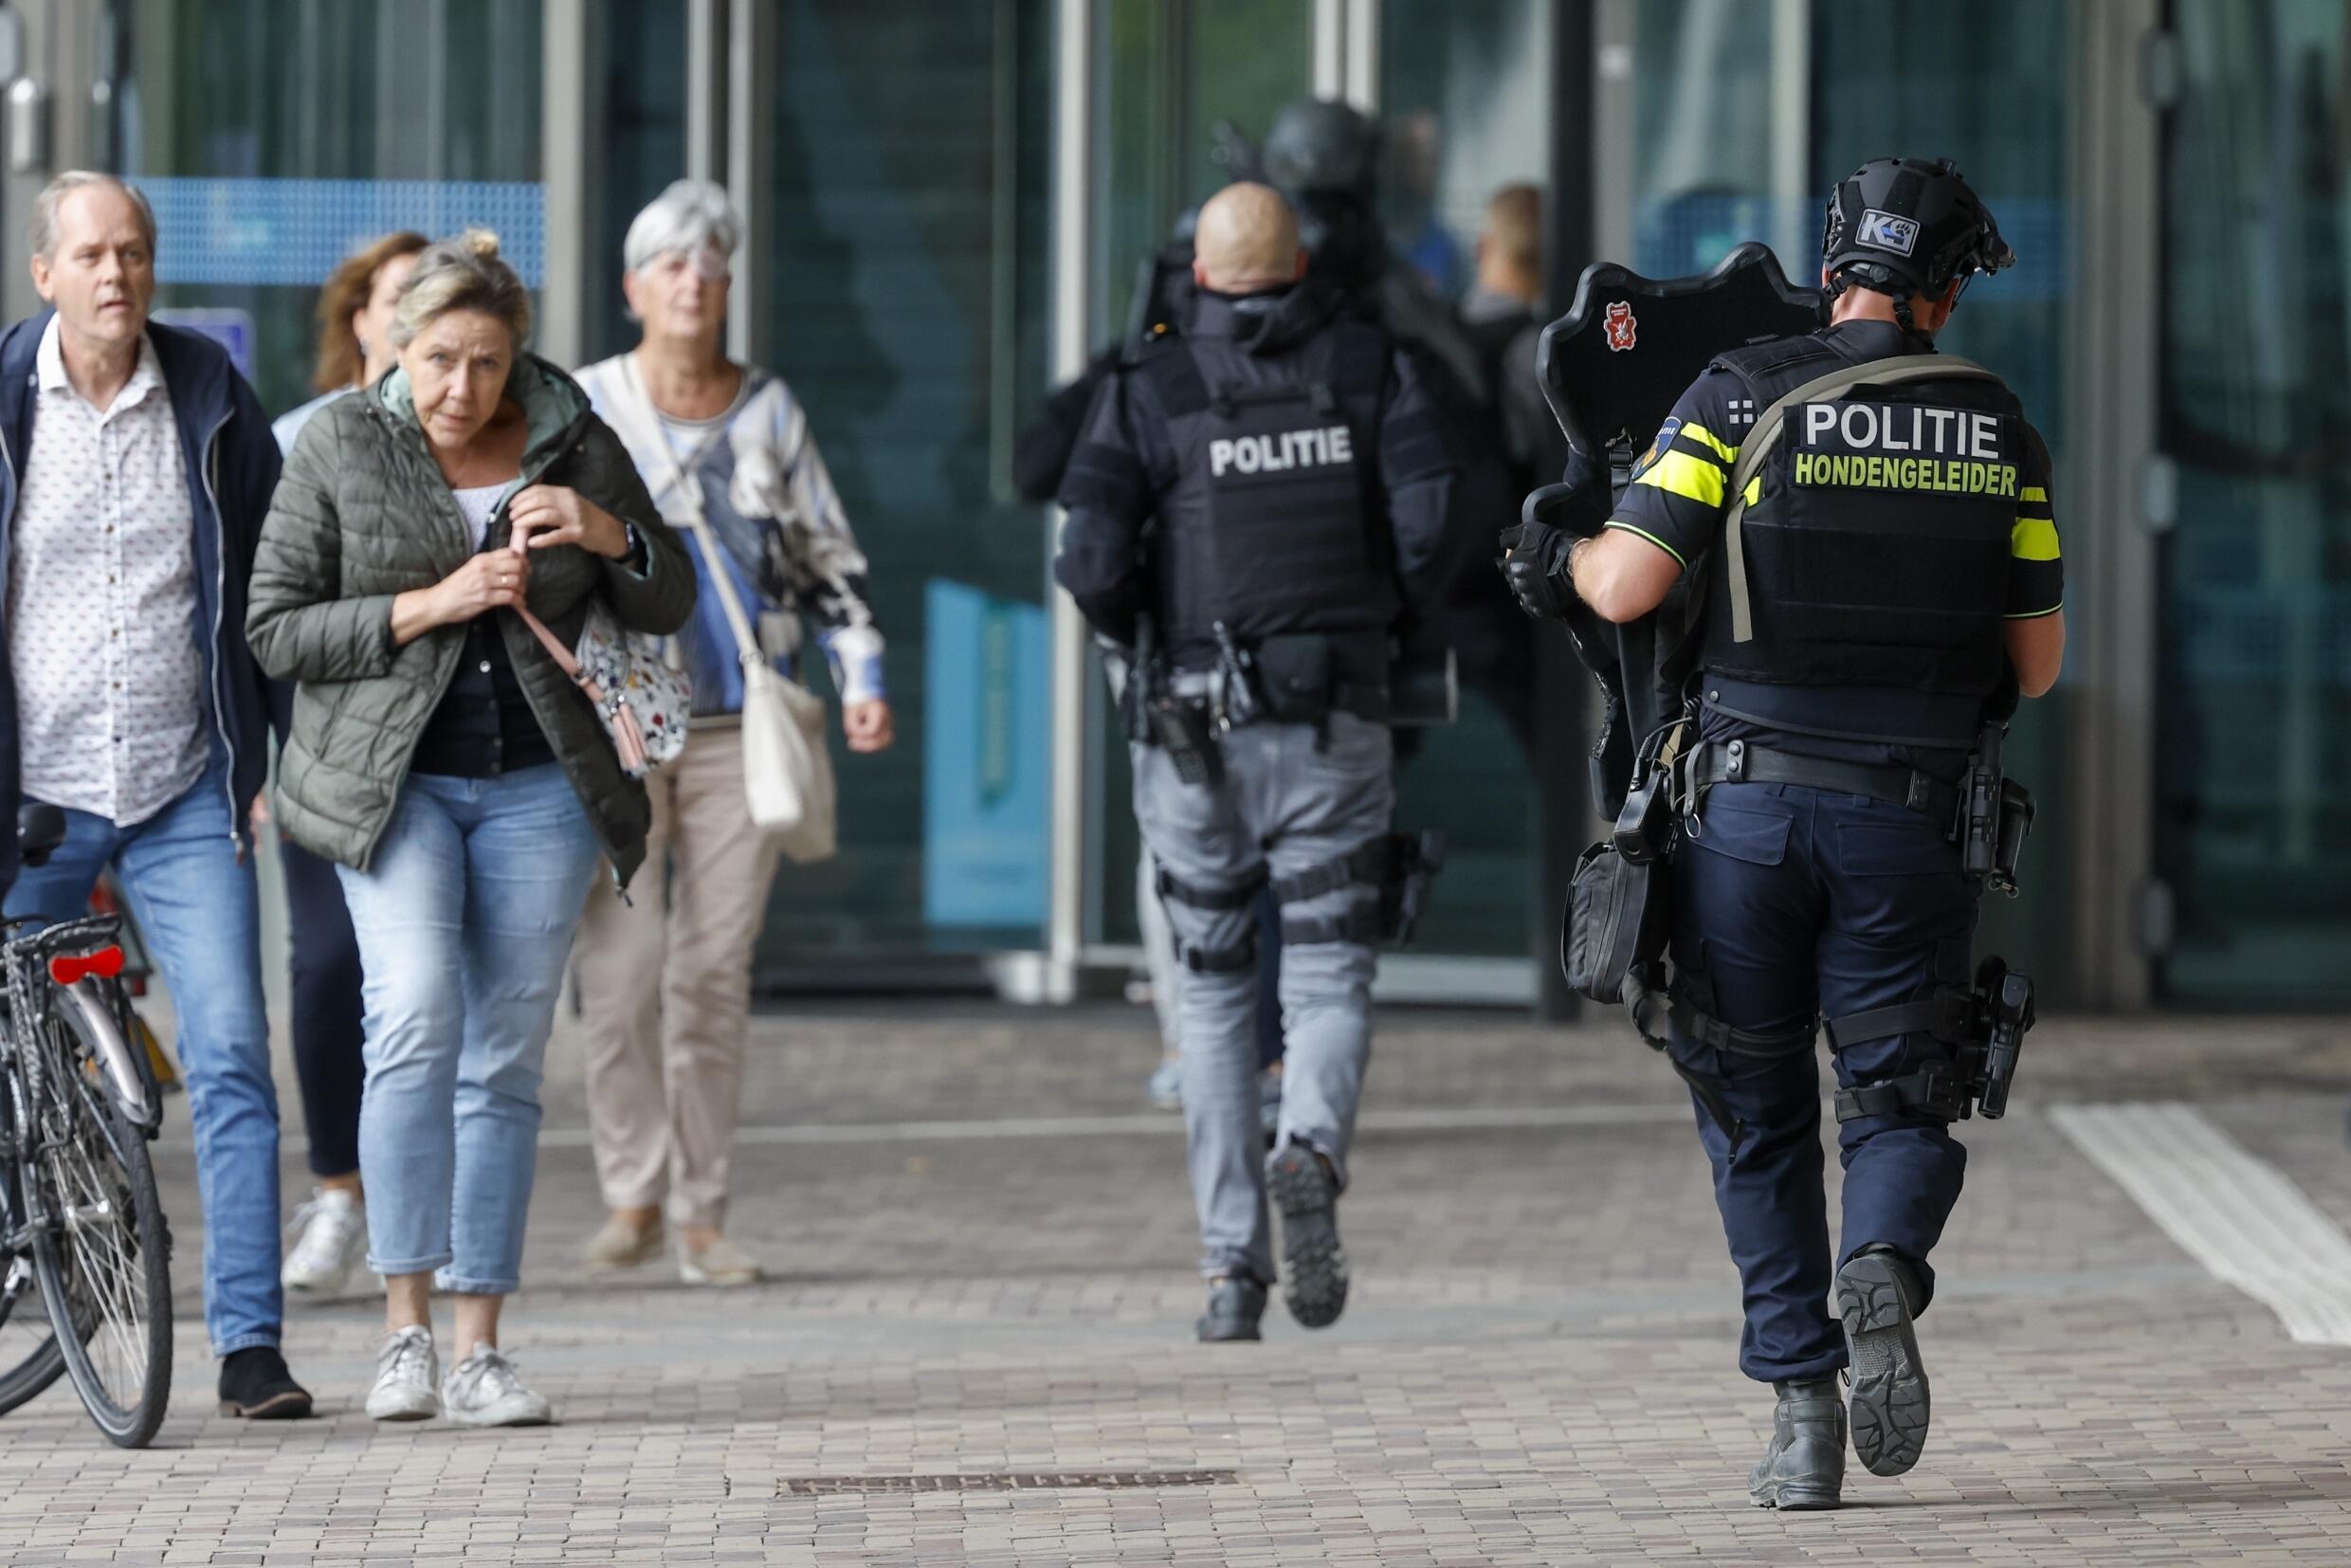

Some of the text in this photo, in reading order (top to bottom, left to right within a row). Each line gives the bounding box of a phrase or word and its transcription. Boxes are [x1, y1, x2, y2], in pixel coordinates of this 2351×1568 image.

[1861, 213, 1916, 252] K9
[1209, 425, 1353, 477] POLITIE
[1806, 404, 1999, 459] POLITIE
[1795, 453, 2016, 497] HONDENGELEIDER
